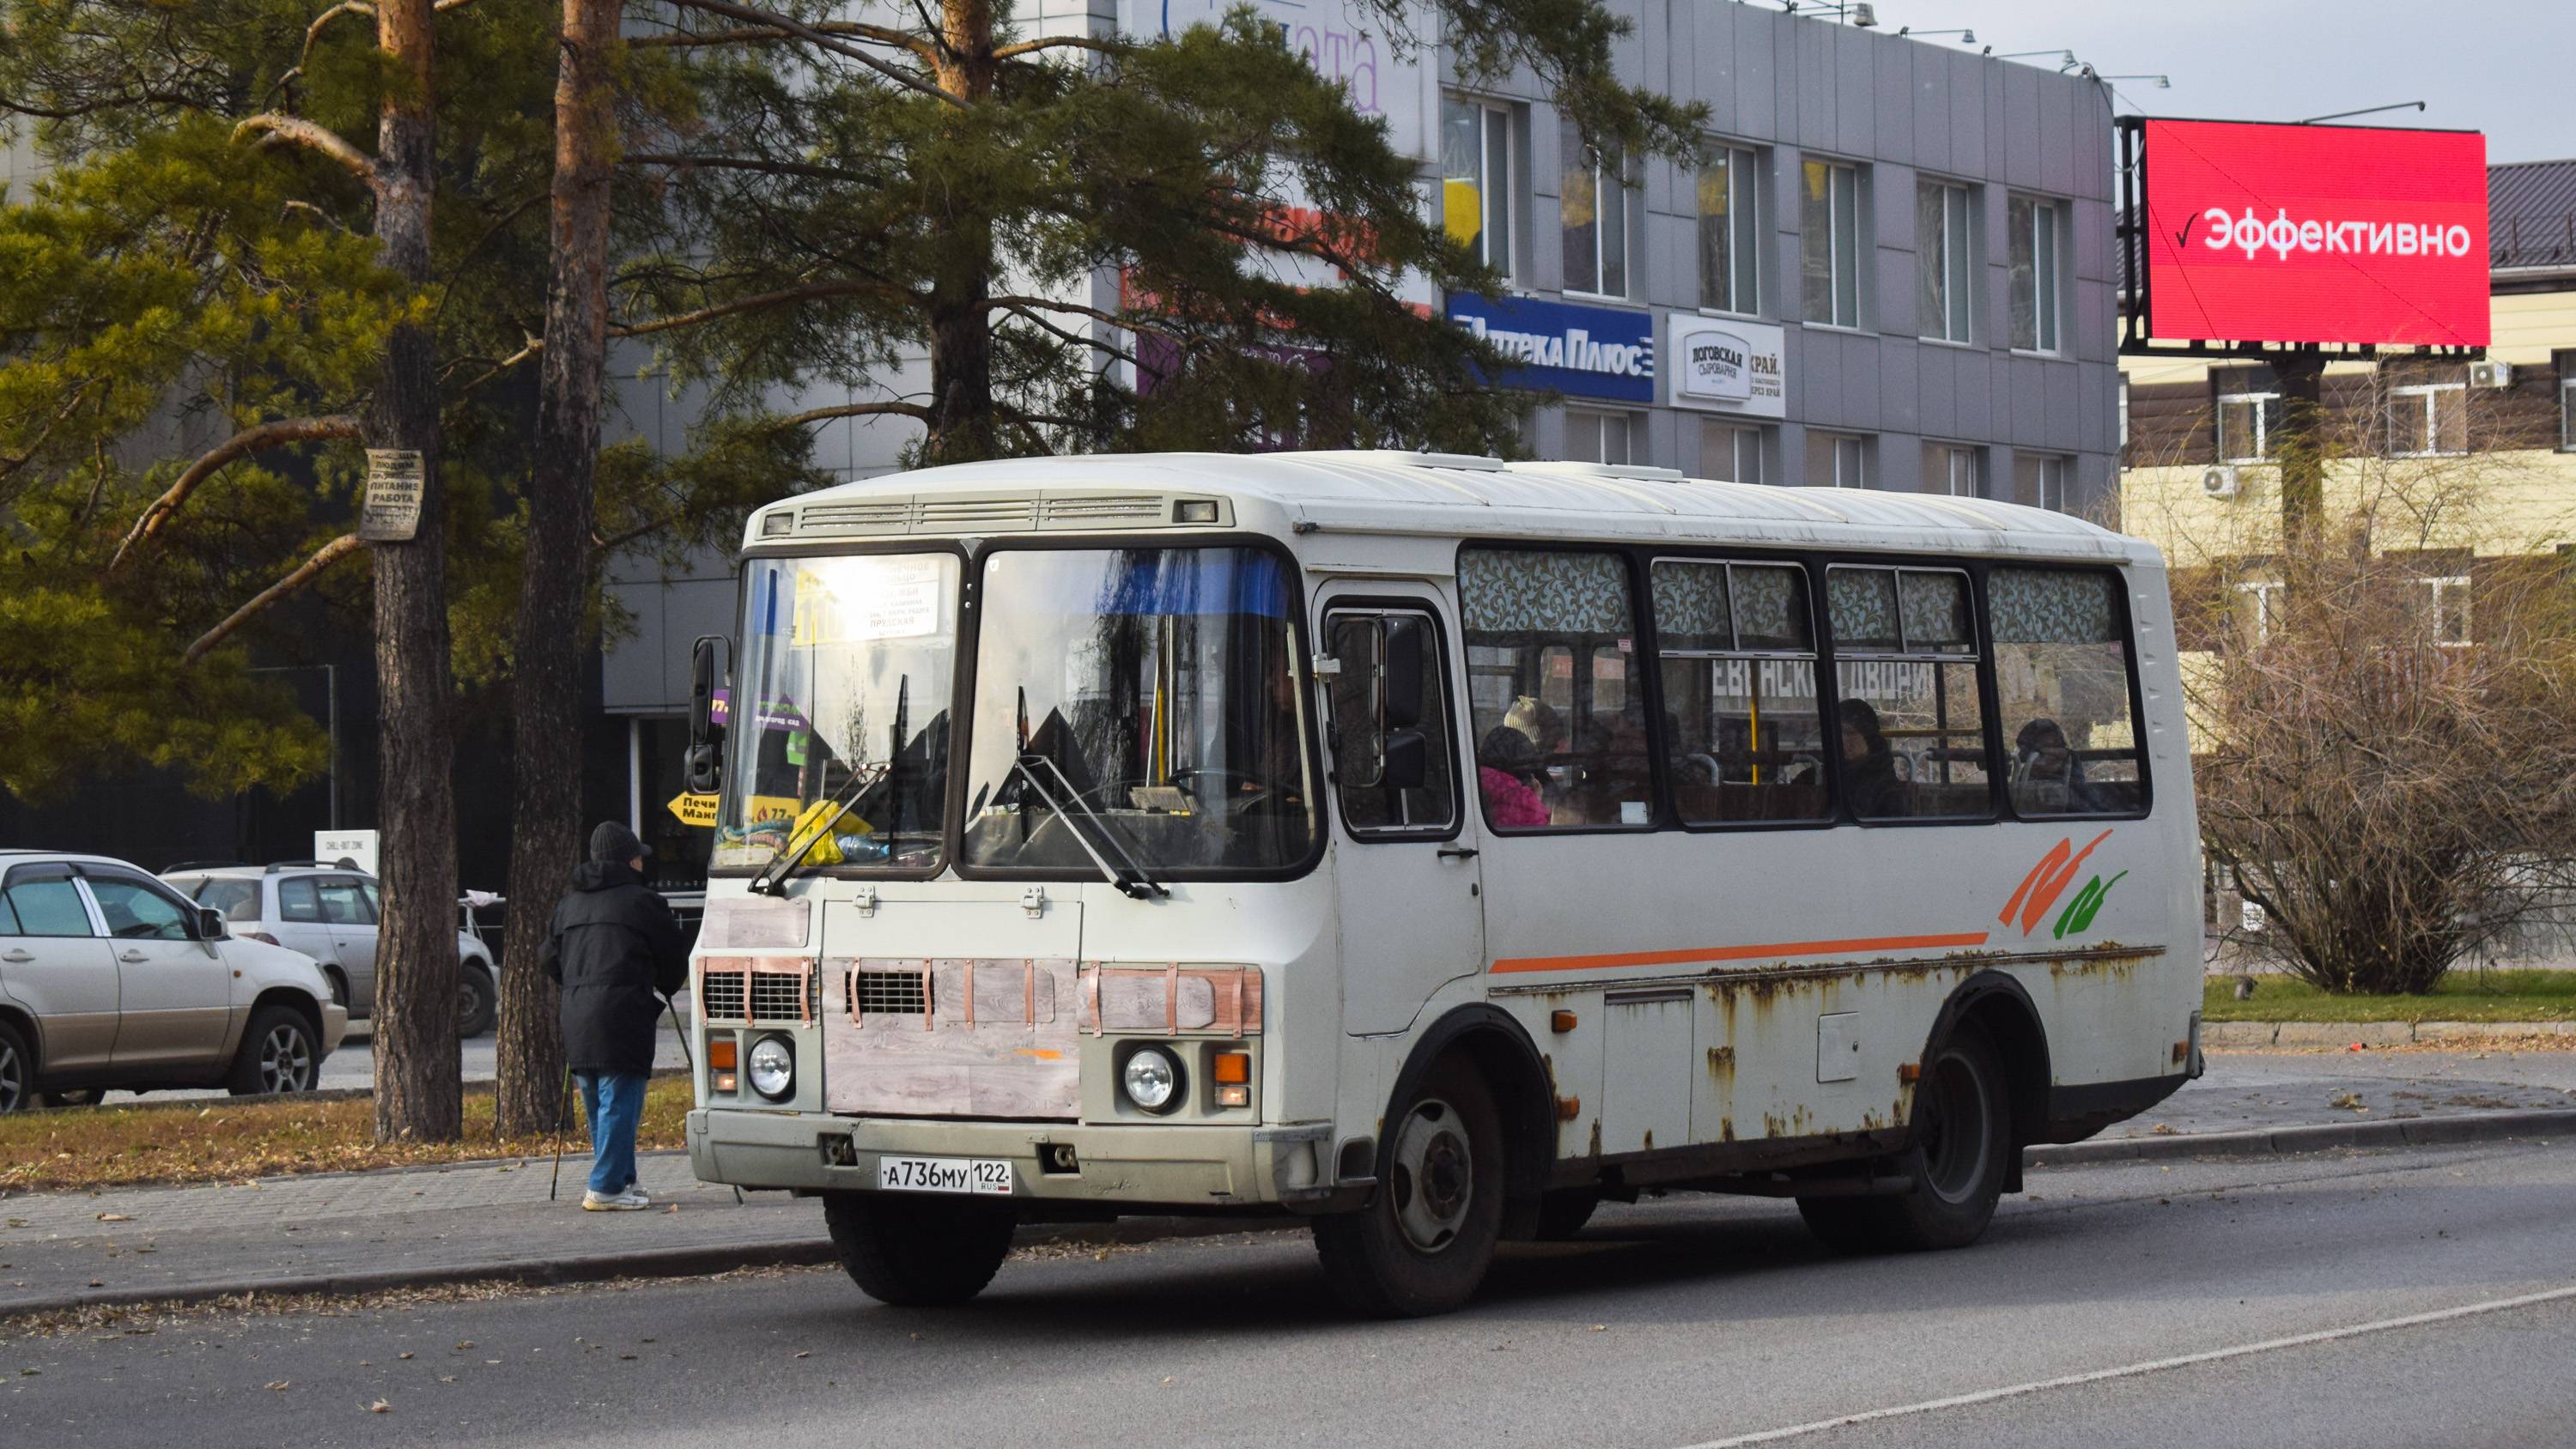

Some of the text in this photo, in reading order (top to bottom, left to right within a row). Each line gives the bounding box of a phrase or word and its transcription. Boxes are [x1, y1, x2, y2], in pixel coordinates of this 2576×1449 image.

[2203, 207, 2471, 260] Эффективно
[1692, 345, 1743, 367] ЛОГОВСКАЯ
[370, 482, 419, 491] ПИТАНИЕ
[372, 494, 415, 502] РАБОТА
[1849, 661, 1936, 700] ДВОРИ
[683, 797, 716, 809] Печи
[974, 1163, 1005, 1182] 122
